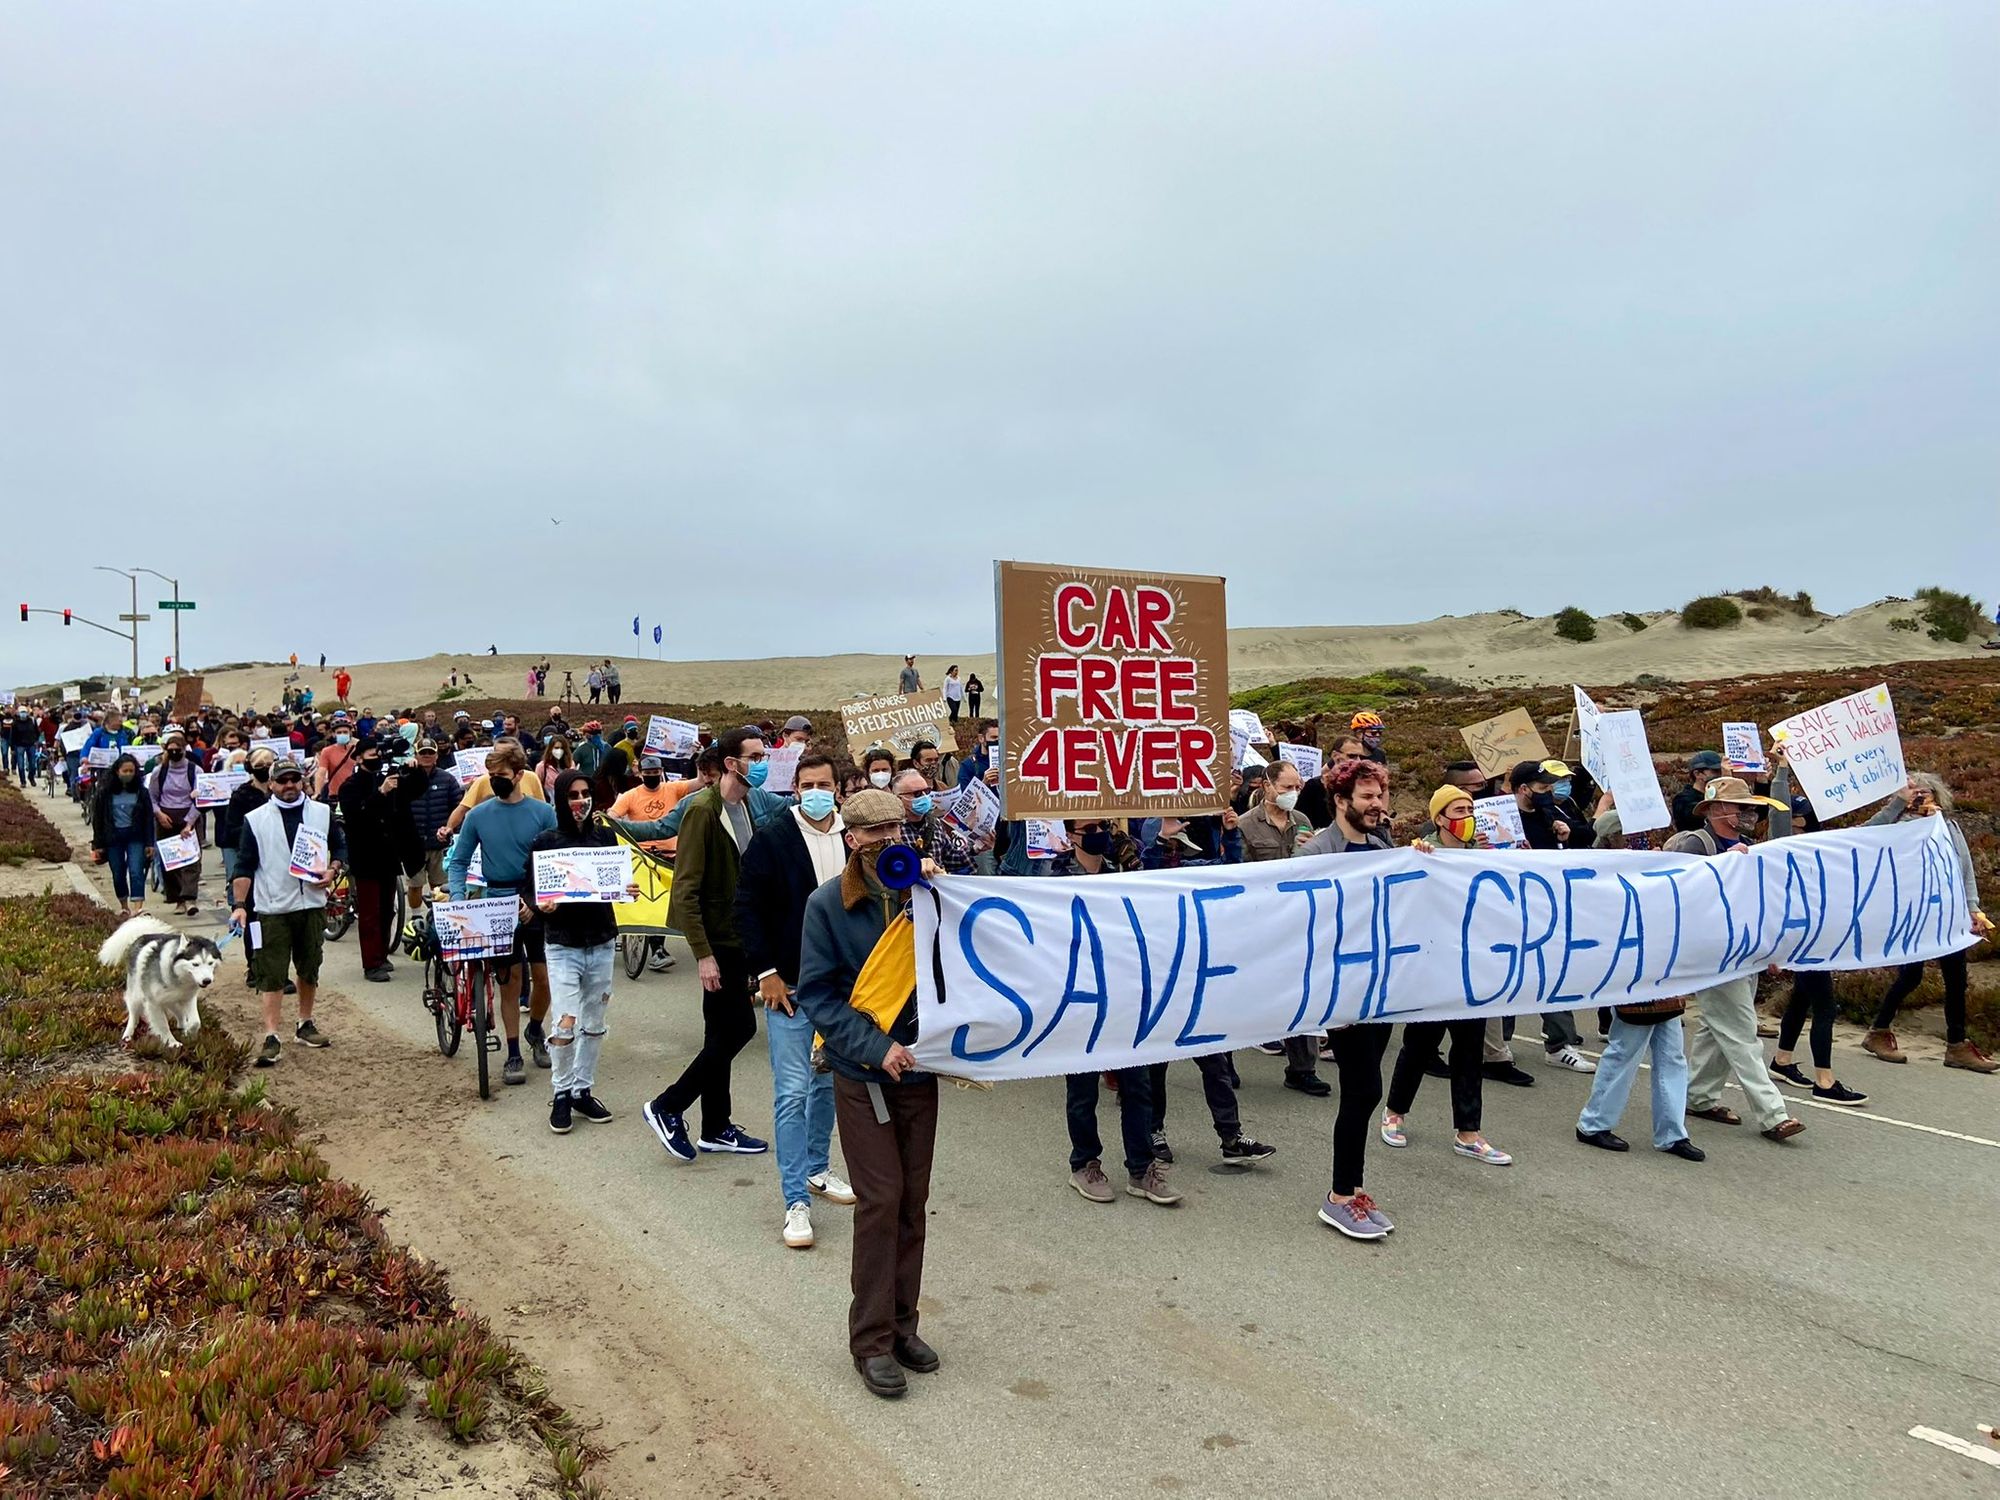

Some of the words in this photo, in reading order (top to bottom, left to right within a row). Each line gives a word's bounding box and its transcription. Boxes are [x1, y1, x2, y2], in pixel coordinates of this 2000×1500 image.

[1054, 582, 1174, 653] CAR
[841, 699, 874, 717] PROTECT
[1035, 653, 1198, 726] FREE
[846, 719, 860, 735] &
[858, 697, 948, 735] PEDESTRIANS!
[1784, 728, 1842, 763] GREAT
[1845, 710, 1898, 742] WALKWAY
[1786, 706, 1840, 738] SAVE
[1841, 692, 1877, 720] THE
[1019, 725, 1217, 797] 4EVER
[1825, 756, 1848, 775] for
[1854, 744, 1886, 764] every
[1825, 782, 1848, 804] age
[1862, 754, 1900, 784] ability
[466, 902, 486, 910] Great
[486, 900, 517, 908] Walkway
[951, 885, 1245, 1062] SAVE
[1277, 870, 1429, 1032] THE
[1461, 868, 1687, 1008] GREAT
